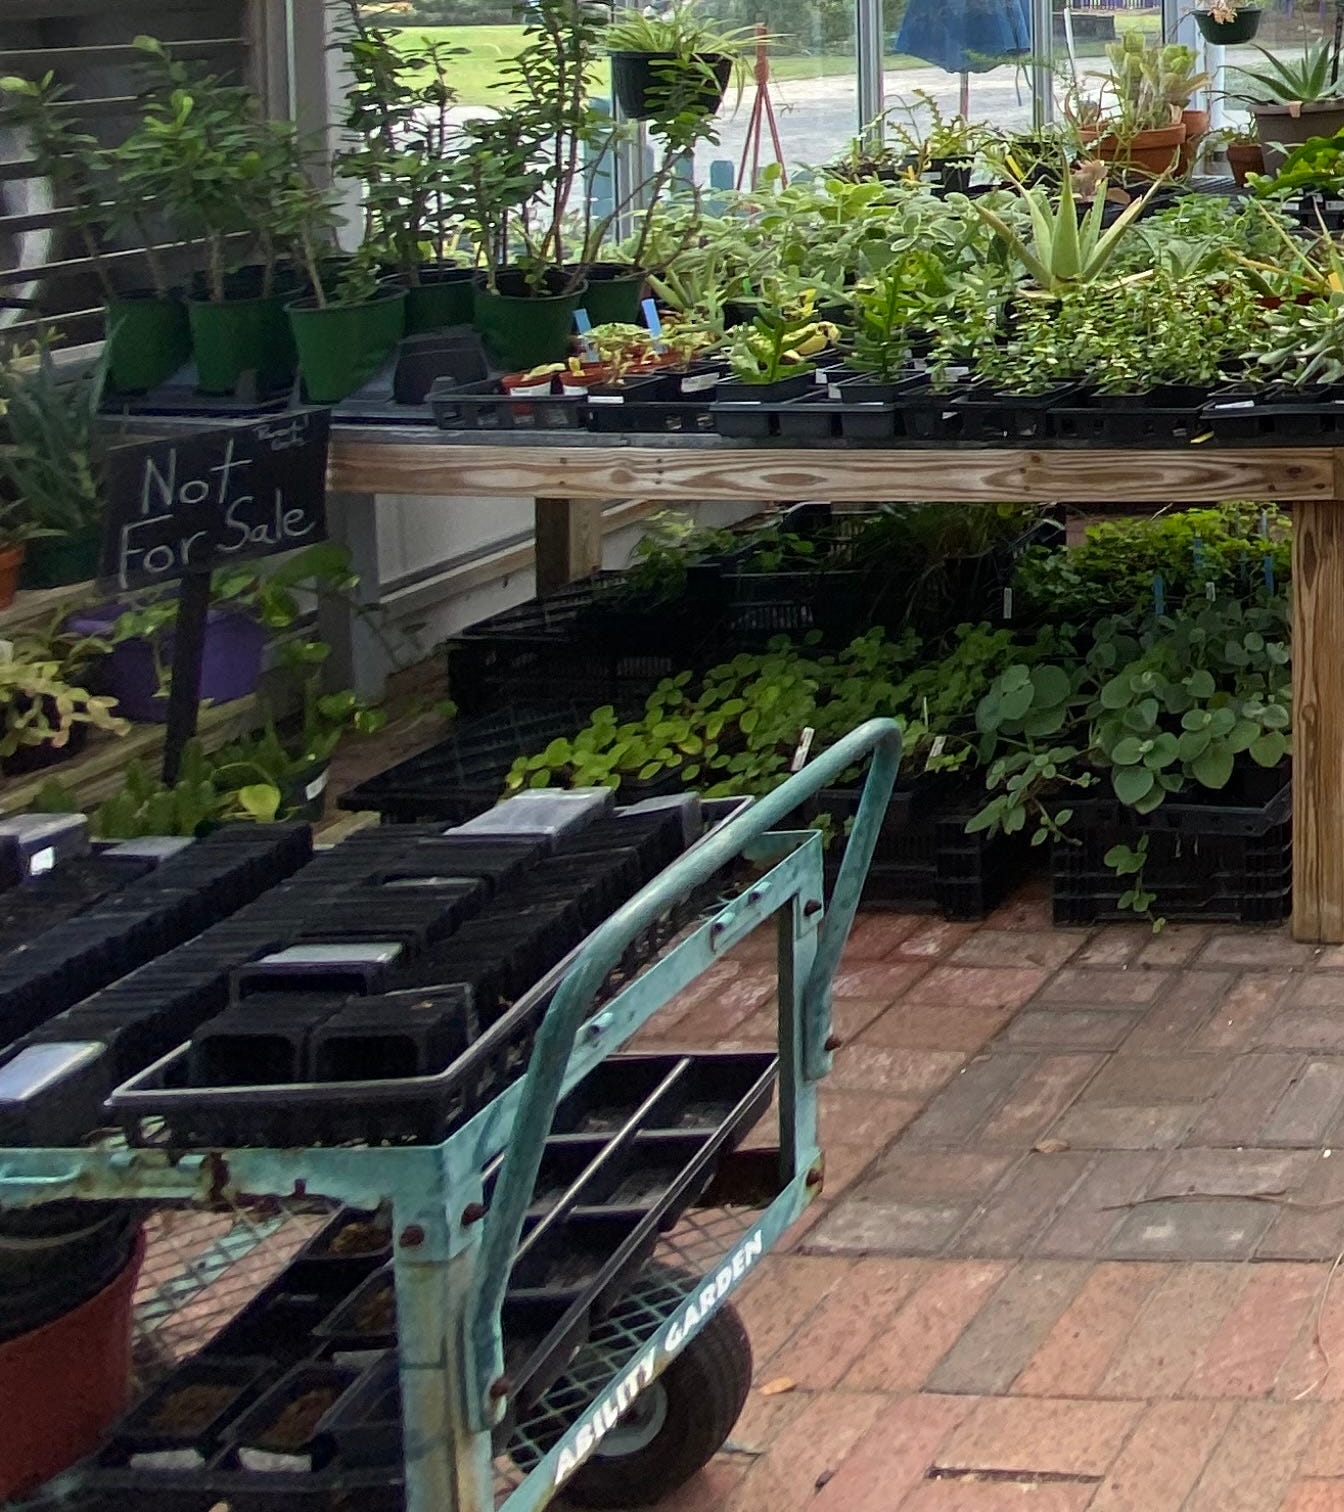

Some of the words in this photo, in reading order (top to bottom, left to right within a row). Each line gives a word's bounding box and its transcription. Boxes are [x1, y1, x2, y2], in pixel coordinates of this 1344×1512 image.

[141, 437, 255, 515] Not
[118, 512, 209, 590] For
[215, 487, 318, 553] Sale
[554, 1345, 658, 1486] ABILITY
[664, 1229, 764, 1353] GARDEN
